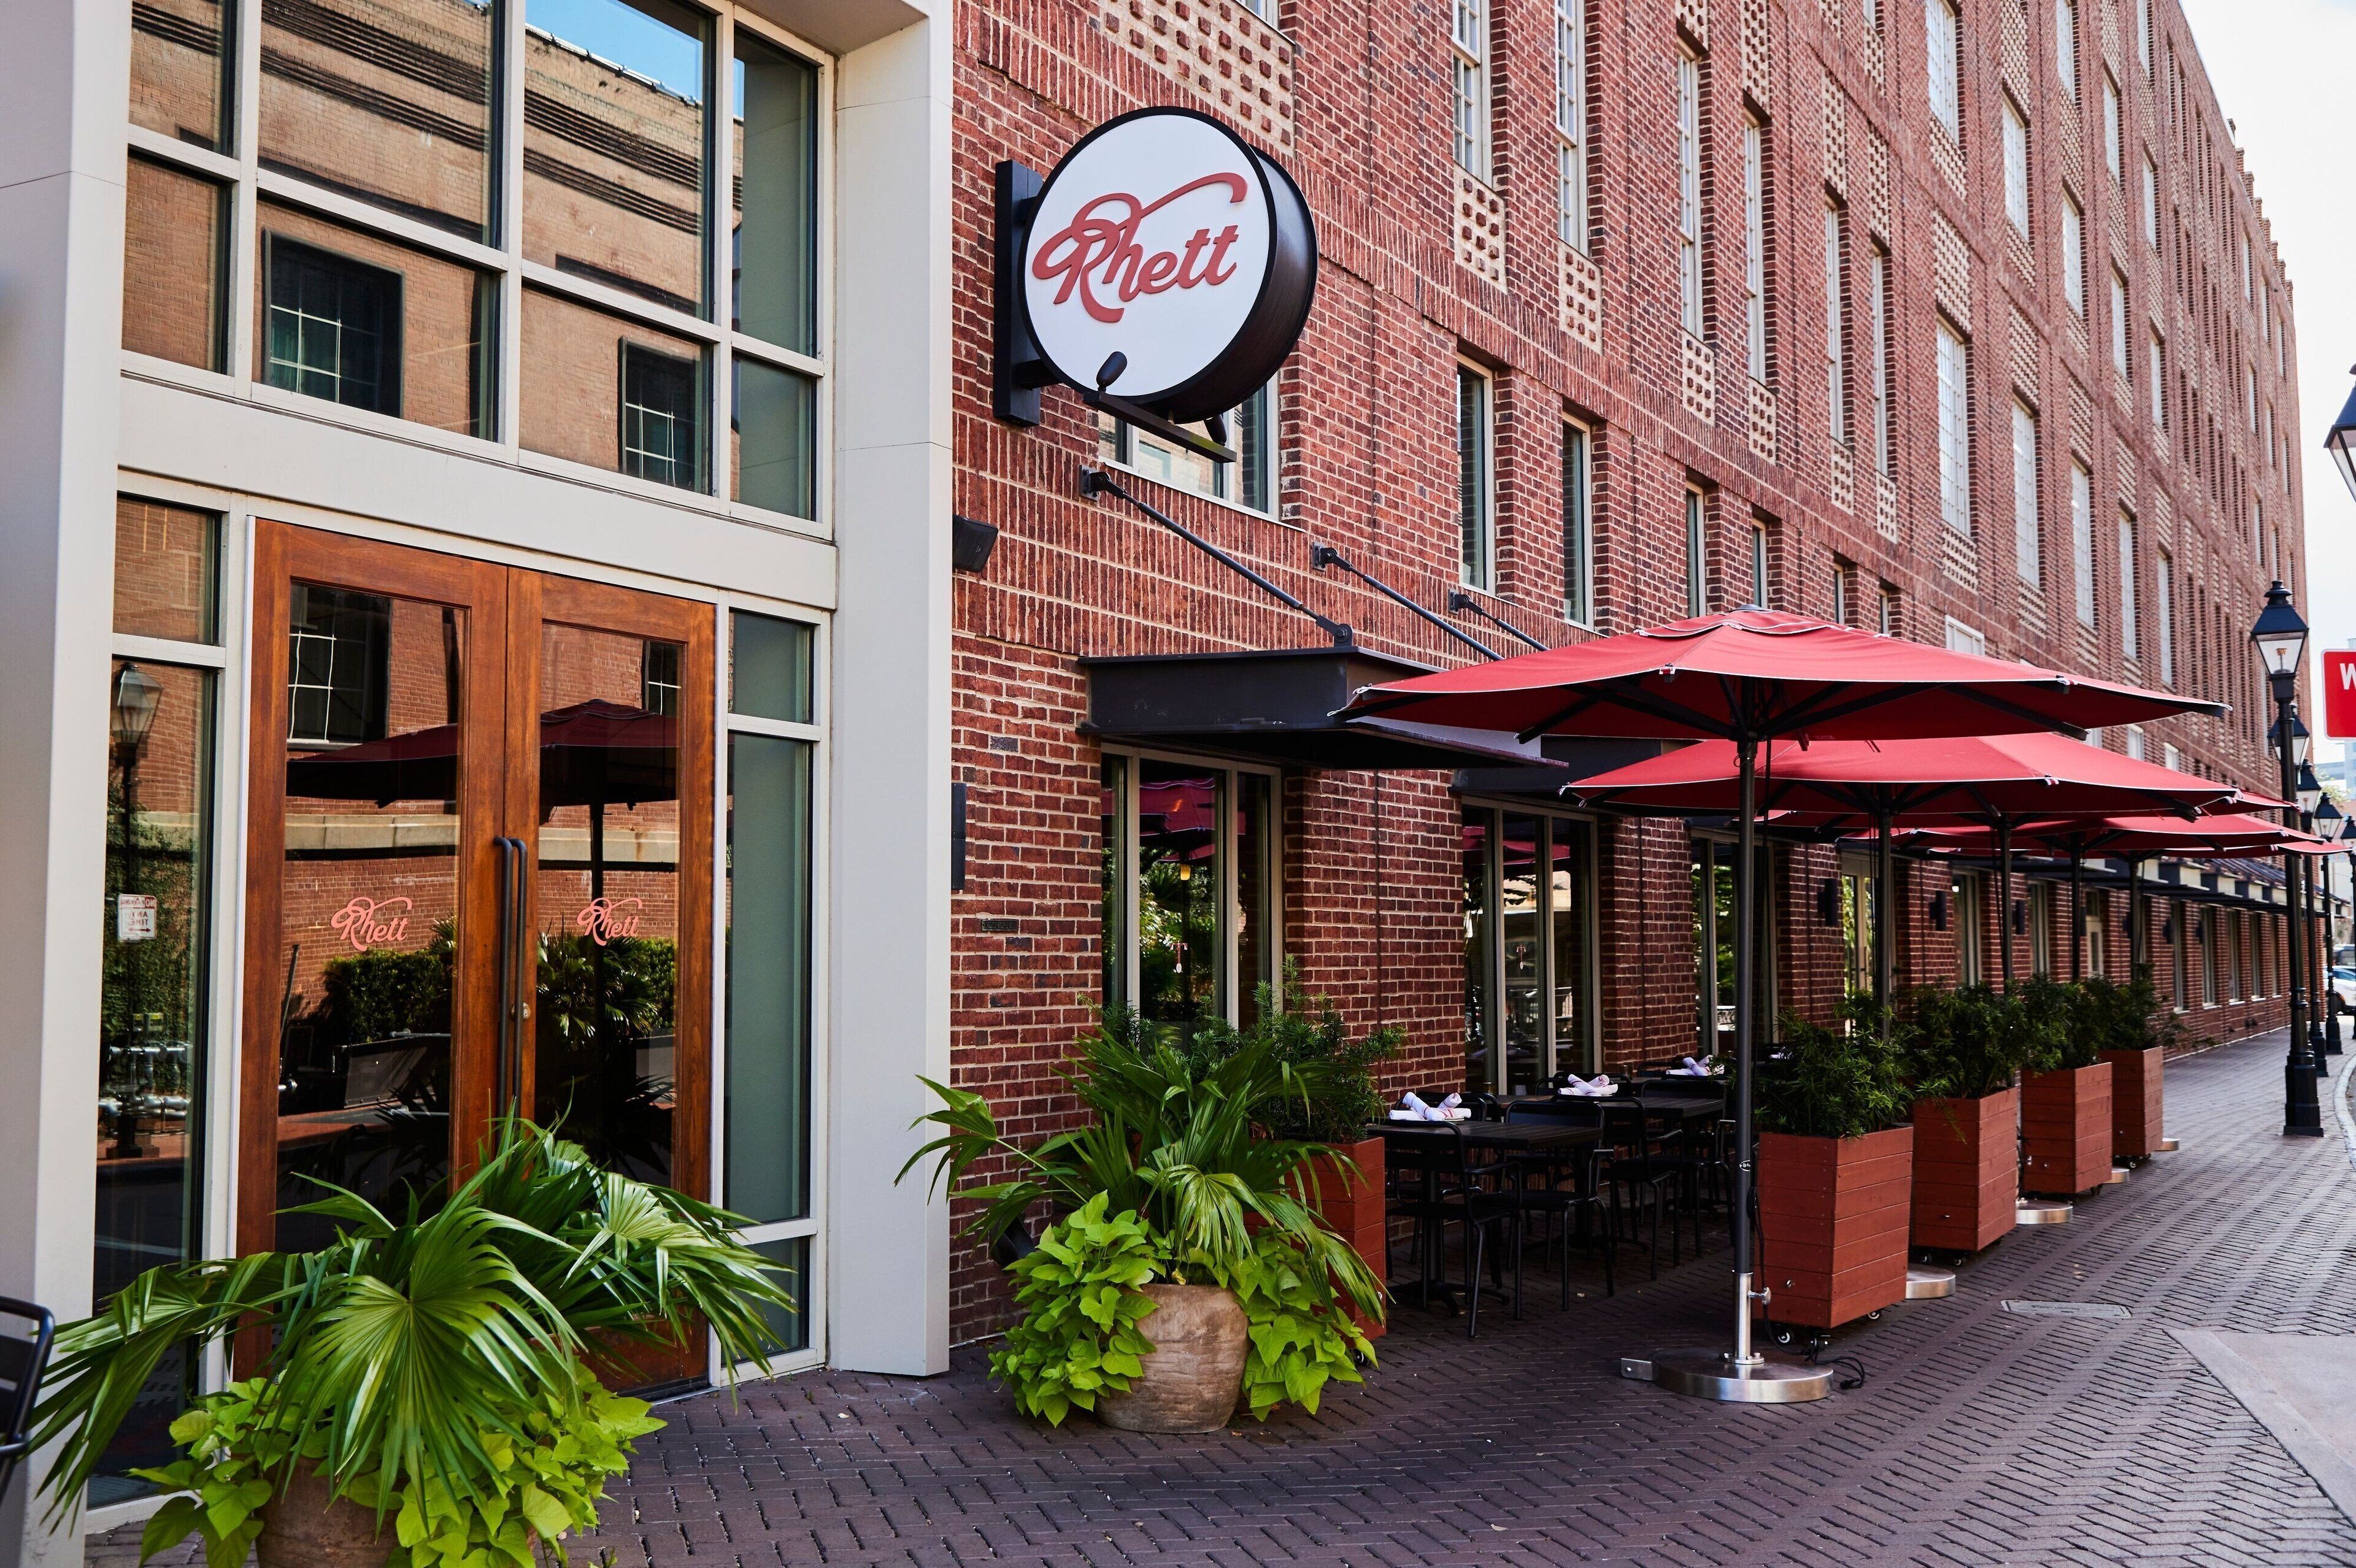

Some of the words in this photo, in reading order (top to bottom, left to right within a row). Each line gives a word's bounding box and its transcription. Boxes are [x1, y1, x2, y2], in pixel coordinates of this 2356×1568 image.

[1032, 172, 1248, 323] Rhett
[331, 896, 413, 951] Rhett
[577, 897, 643, 946] Rhett
